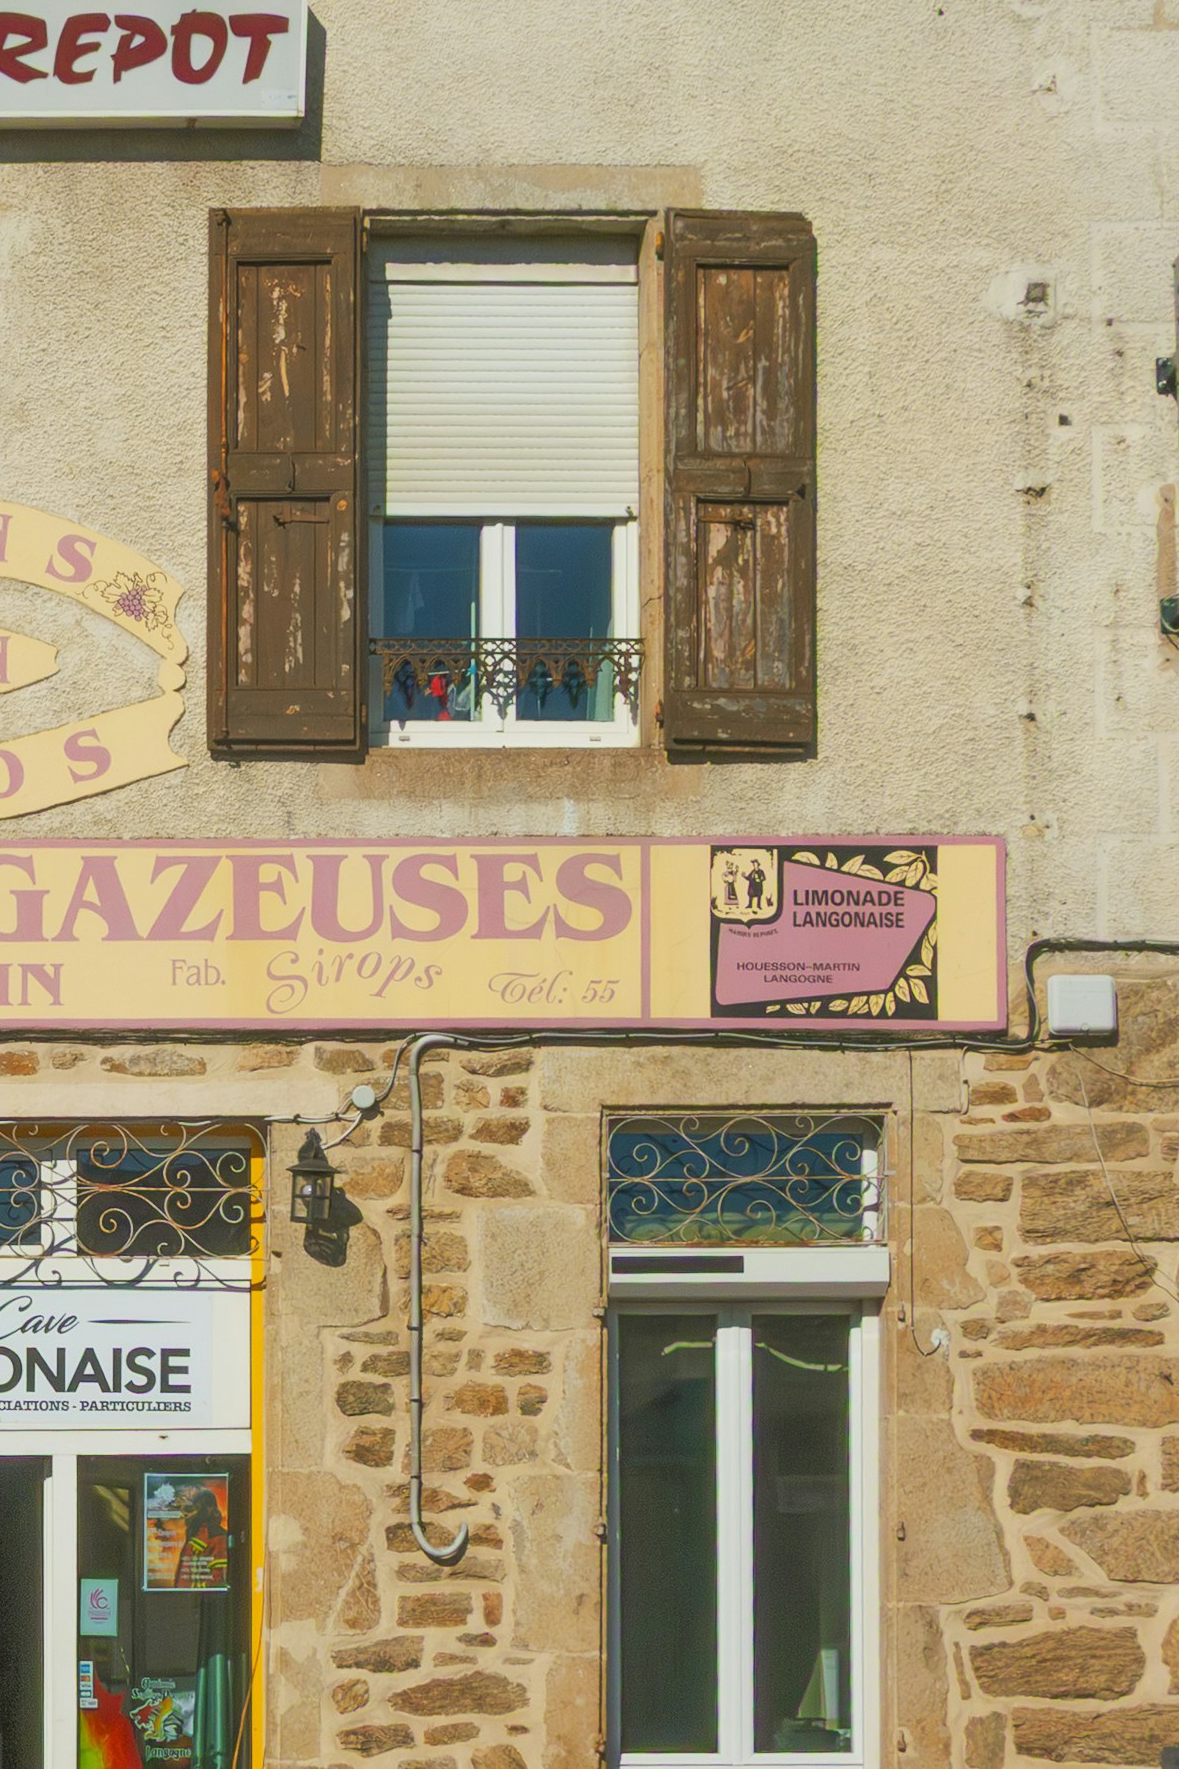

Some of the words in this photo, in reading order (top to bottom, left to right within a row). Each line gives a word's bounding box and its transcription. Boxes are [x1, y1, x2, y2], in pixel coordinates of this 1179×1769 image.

[793, 889, 905, 907] LIMONADE
[793, 911, 905, 928] LANGONAISE
[170, 959, 226, 987] Fab.
[266, 949, 444, 1015] Sirops
[763, 974, 833, 984] LANGOGNE
[581, 980, 621, 1004] 55
[80, 1401, 192, 1413] PARTICULIERS
